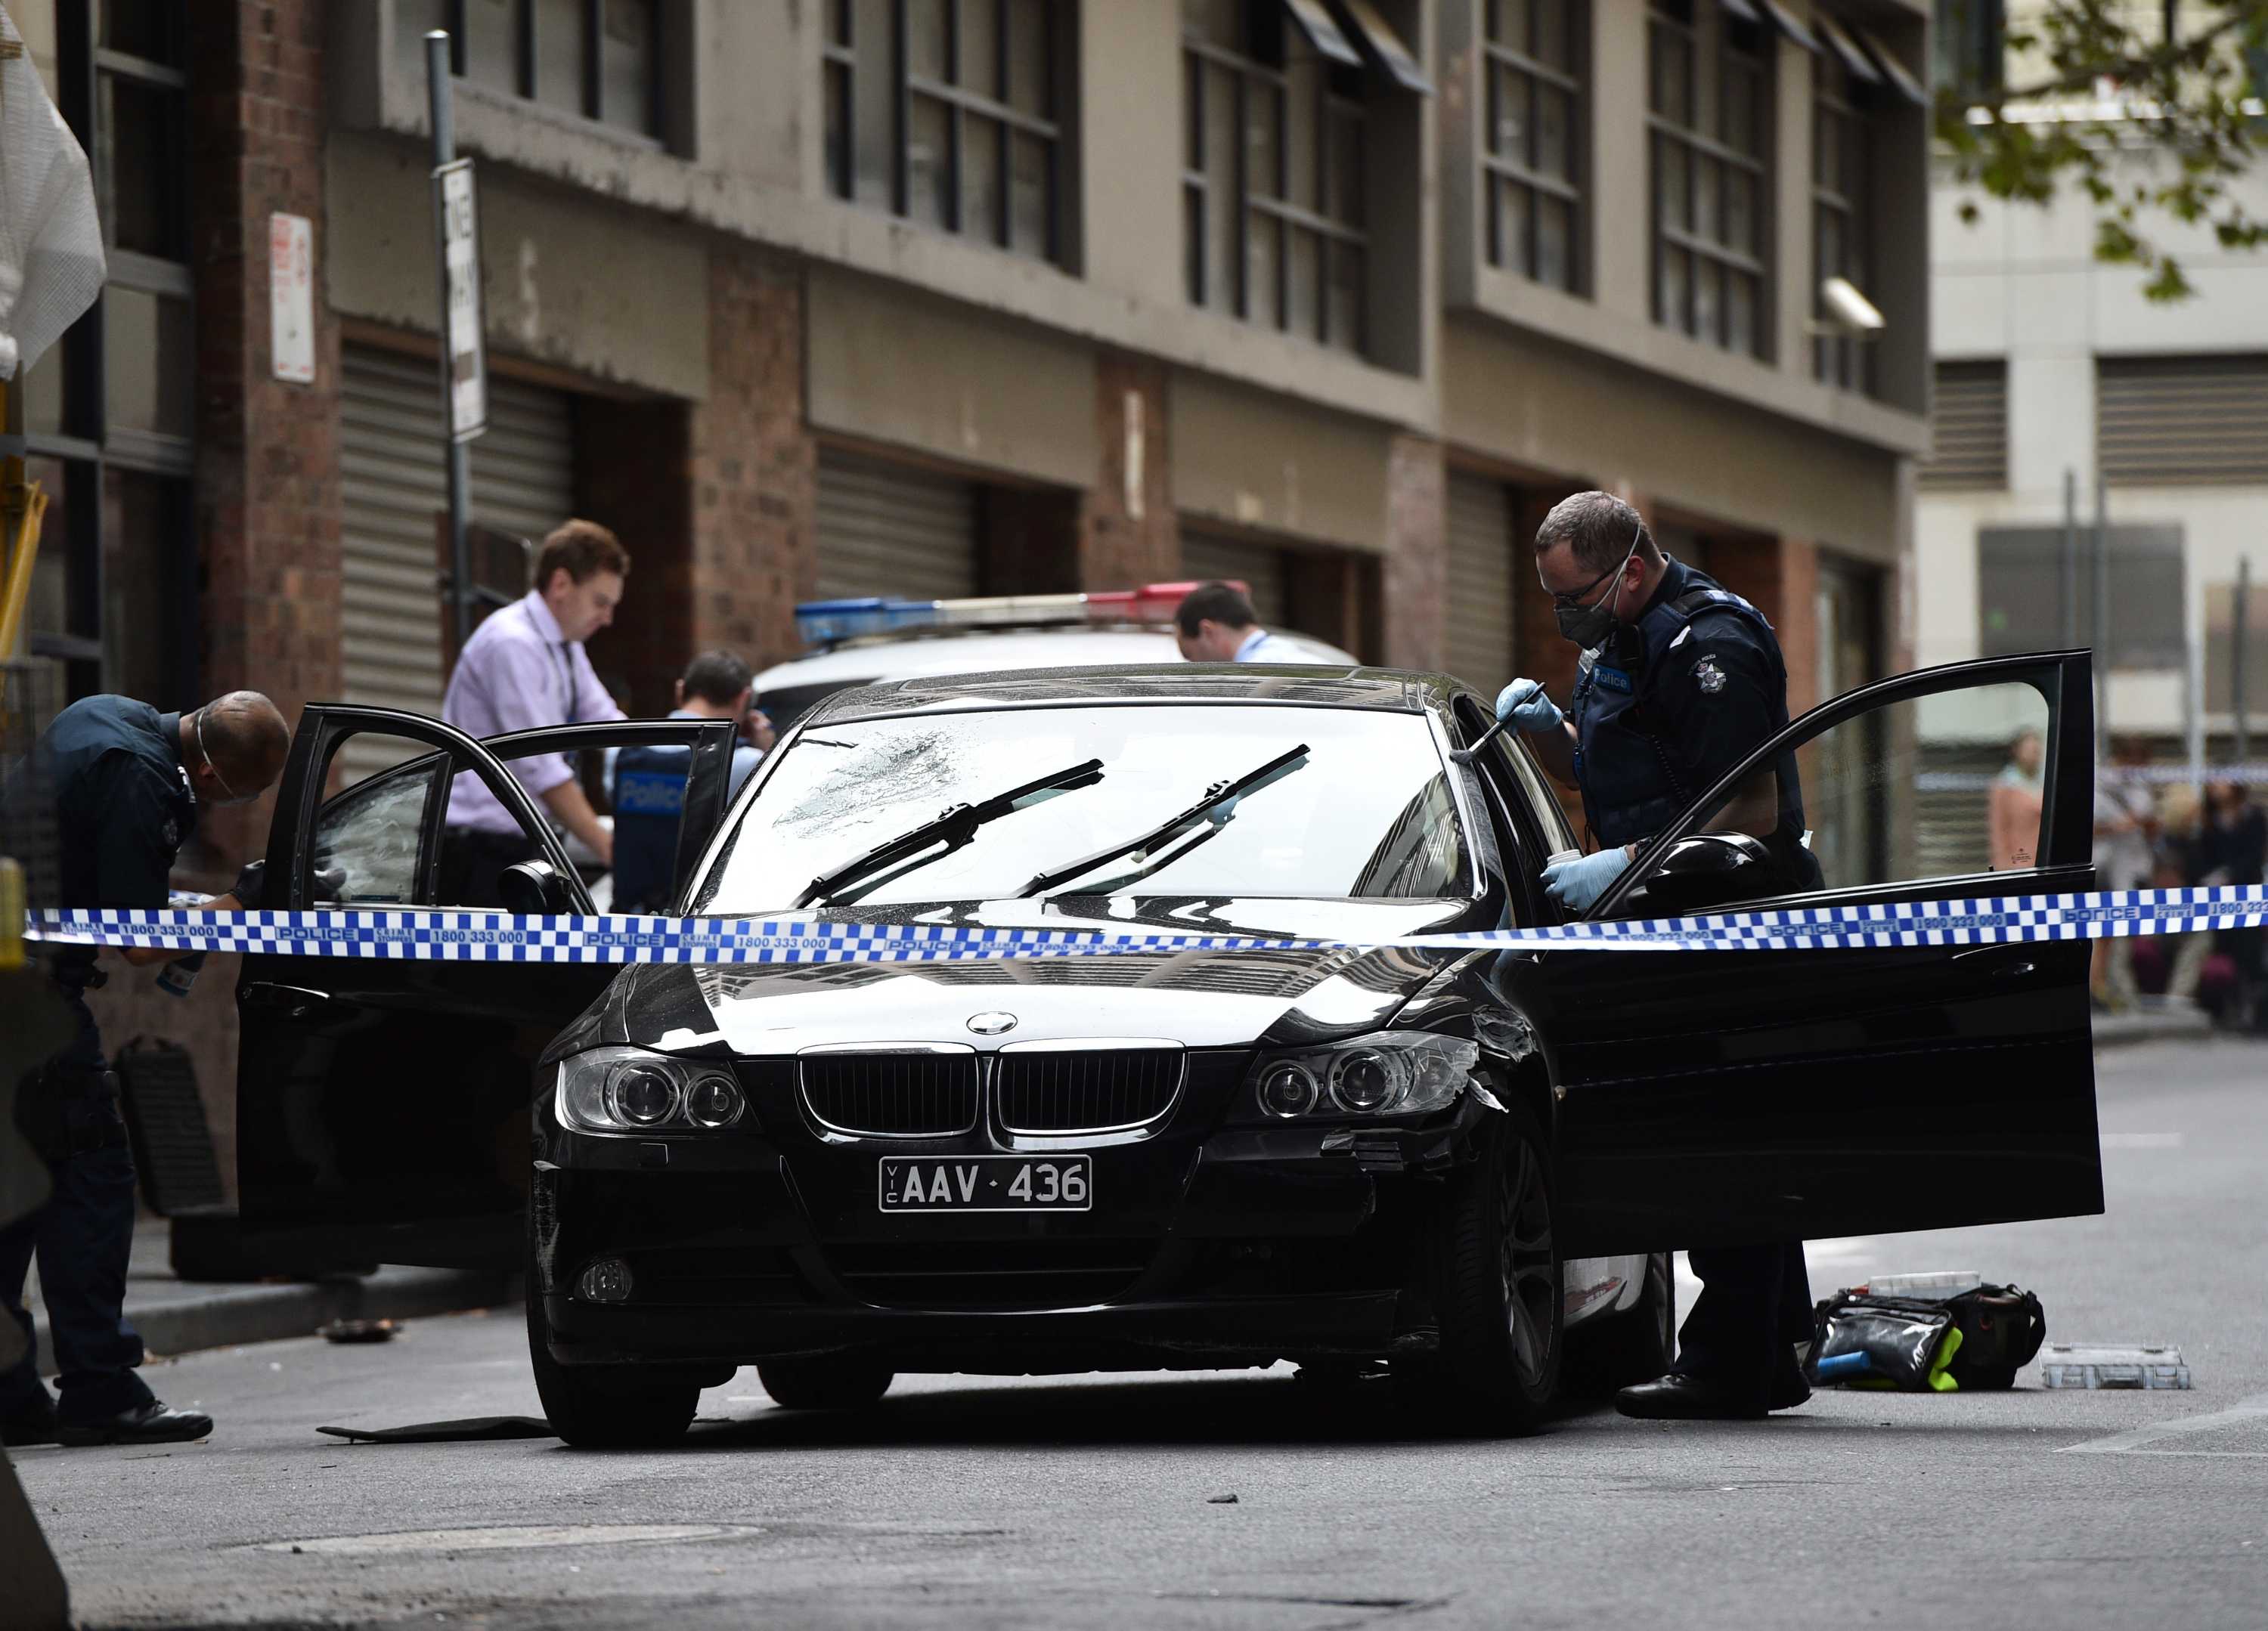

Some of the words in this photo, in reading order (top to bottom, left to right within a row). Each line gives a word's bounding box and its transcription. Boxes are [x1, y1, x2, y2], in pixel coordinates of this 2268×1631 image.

[1594, 667, 1627, 689] Police
[122, 925, 155, 935] 1800
[160, 926, 184, 936] 333
[190, 927, 214, 936] 000
[279, 929, 355, 940] POLICE
[434, 931, 465, 942] 1800
[470, 932, 494, 942] 333
[499, 933, 522, 943] 000
[587, 934, 661, 945] POLICE
[739, 936, 770, 948] 1800
[774, 938, 798, 948] 333
[803, 938, 826, 949] 000
[888, 940, 962, 951] POLICE
[887, 1166, 897, 1202] VIC
[903, 1165, 979, 1202] AAV
[1008, 1164, 1086, 1202] 436
